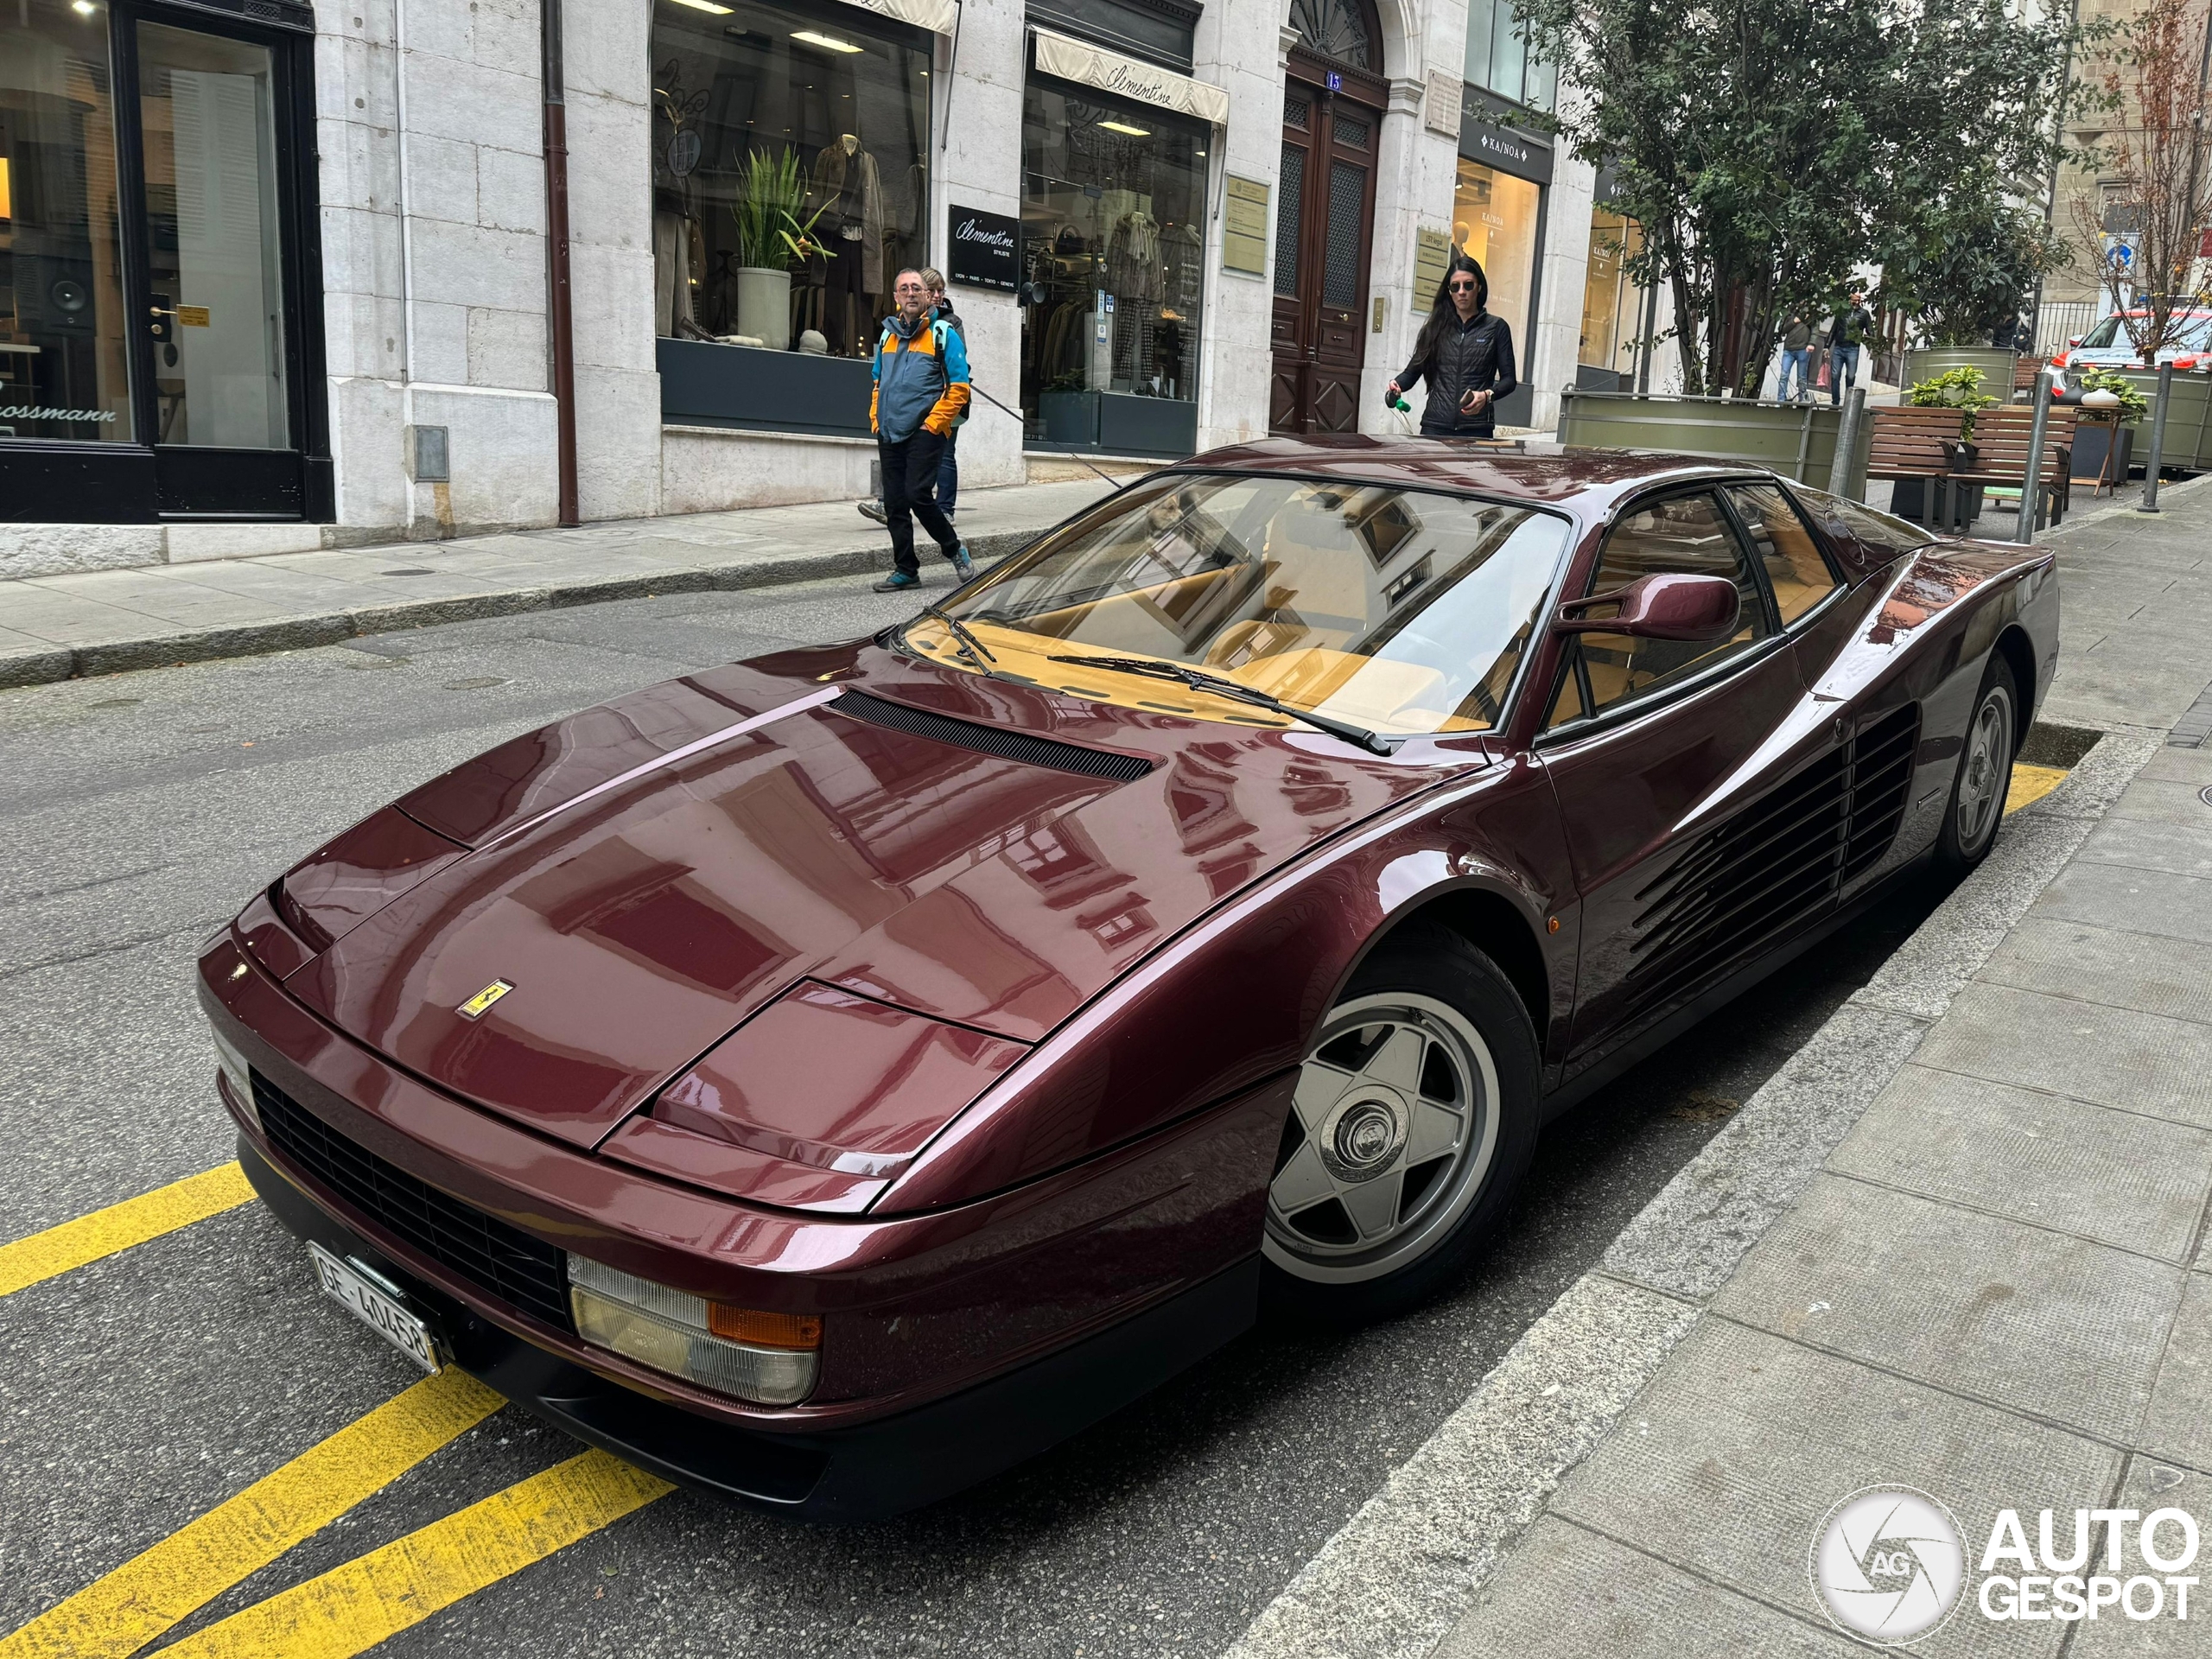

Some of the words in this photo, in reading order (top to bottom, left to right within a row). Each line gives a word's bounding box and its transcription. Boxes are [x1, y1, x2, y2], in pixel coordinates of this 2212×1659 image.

[1329, 73, 1340, 90] 13
[1489, 137, 1520, 159] KA/NOA
[956, 218, 1014, 248] Clémentine
[0, 404, 118, 423] ossmann
[317, 1256, 350, 1303] GE
[357, 1285, 429, 1362] 40458
